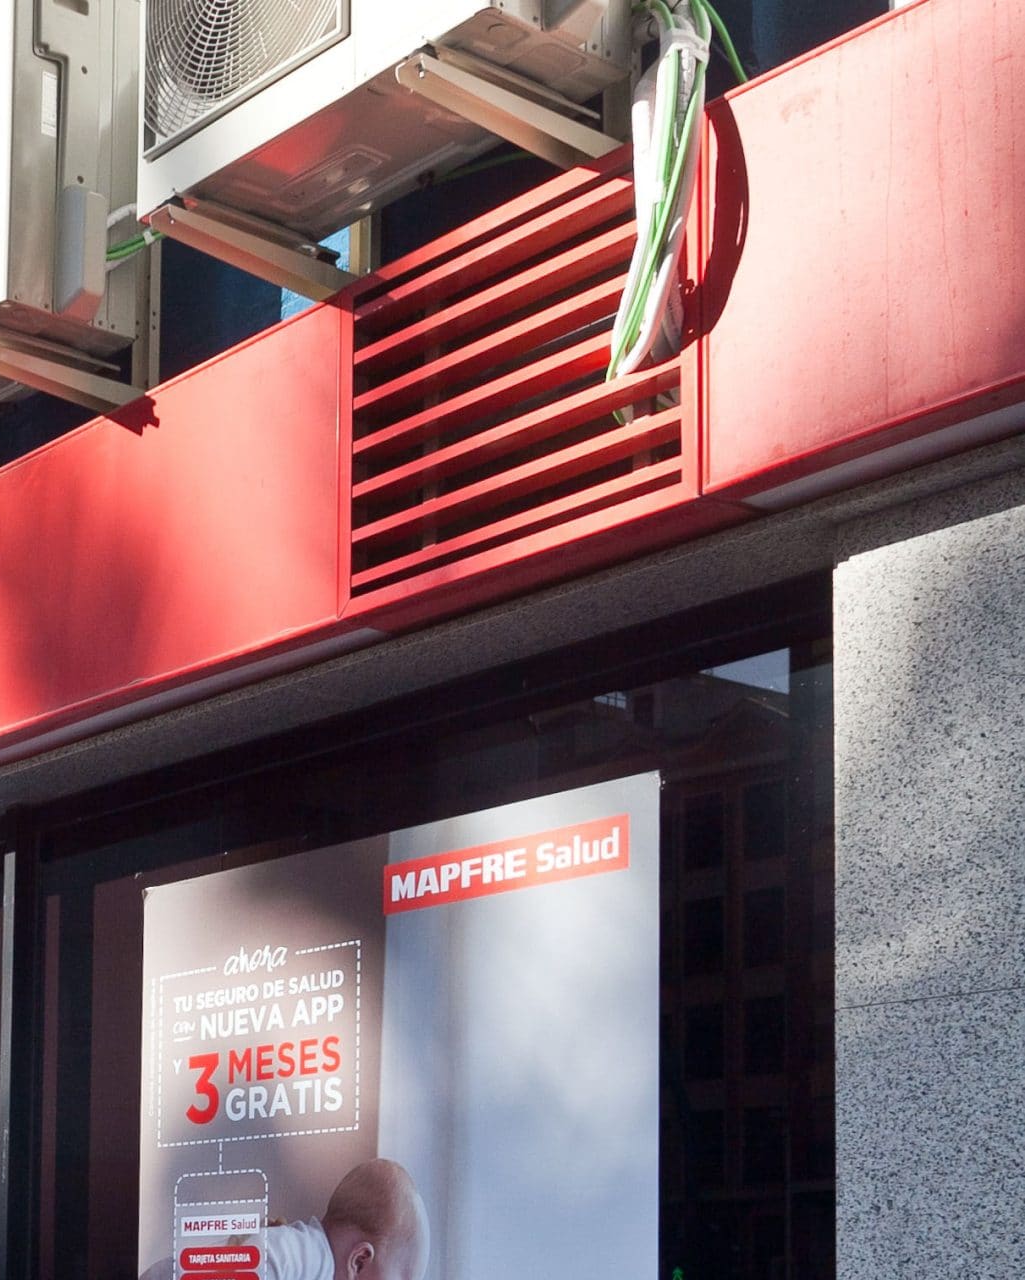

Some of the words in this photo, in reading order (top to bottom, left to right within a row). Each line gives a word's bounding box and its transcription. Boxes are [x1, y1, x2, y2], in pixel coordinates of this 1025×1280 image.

[390, 847, 526, 902] MAPFRE
[535, 827, 620, 873] Salud
[222, 945, 289, 977] ahora
[173, 995, 193, 1014] TU
[196, 984, 260, 1011] SEGURO
[263, 981, 285, 999] DE
[288, 969, 345, 995] SALUD
[199, 1004, 285, 1041] NUEVA
[291, 994, 344, 1027] APP
[172, 1059, 184, 1076] Y
[185, 1052, 220, 1125] 3
[228, 1035, 342, 1085] MESES
[226, 1077, 343, 1122] GRATIS
[184, 1220, 228, 1232] MAPFRE
[231, 1218, 257, 1230] Salud
[188, 1254, 215, 1265] TARJETA
[215, 1253, 252, 1264] SANITARIA
